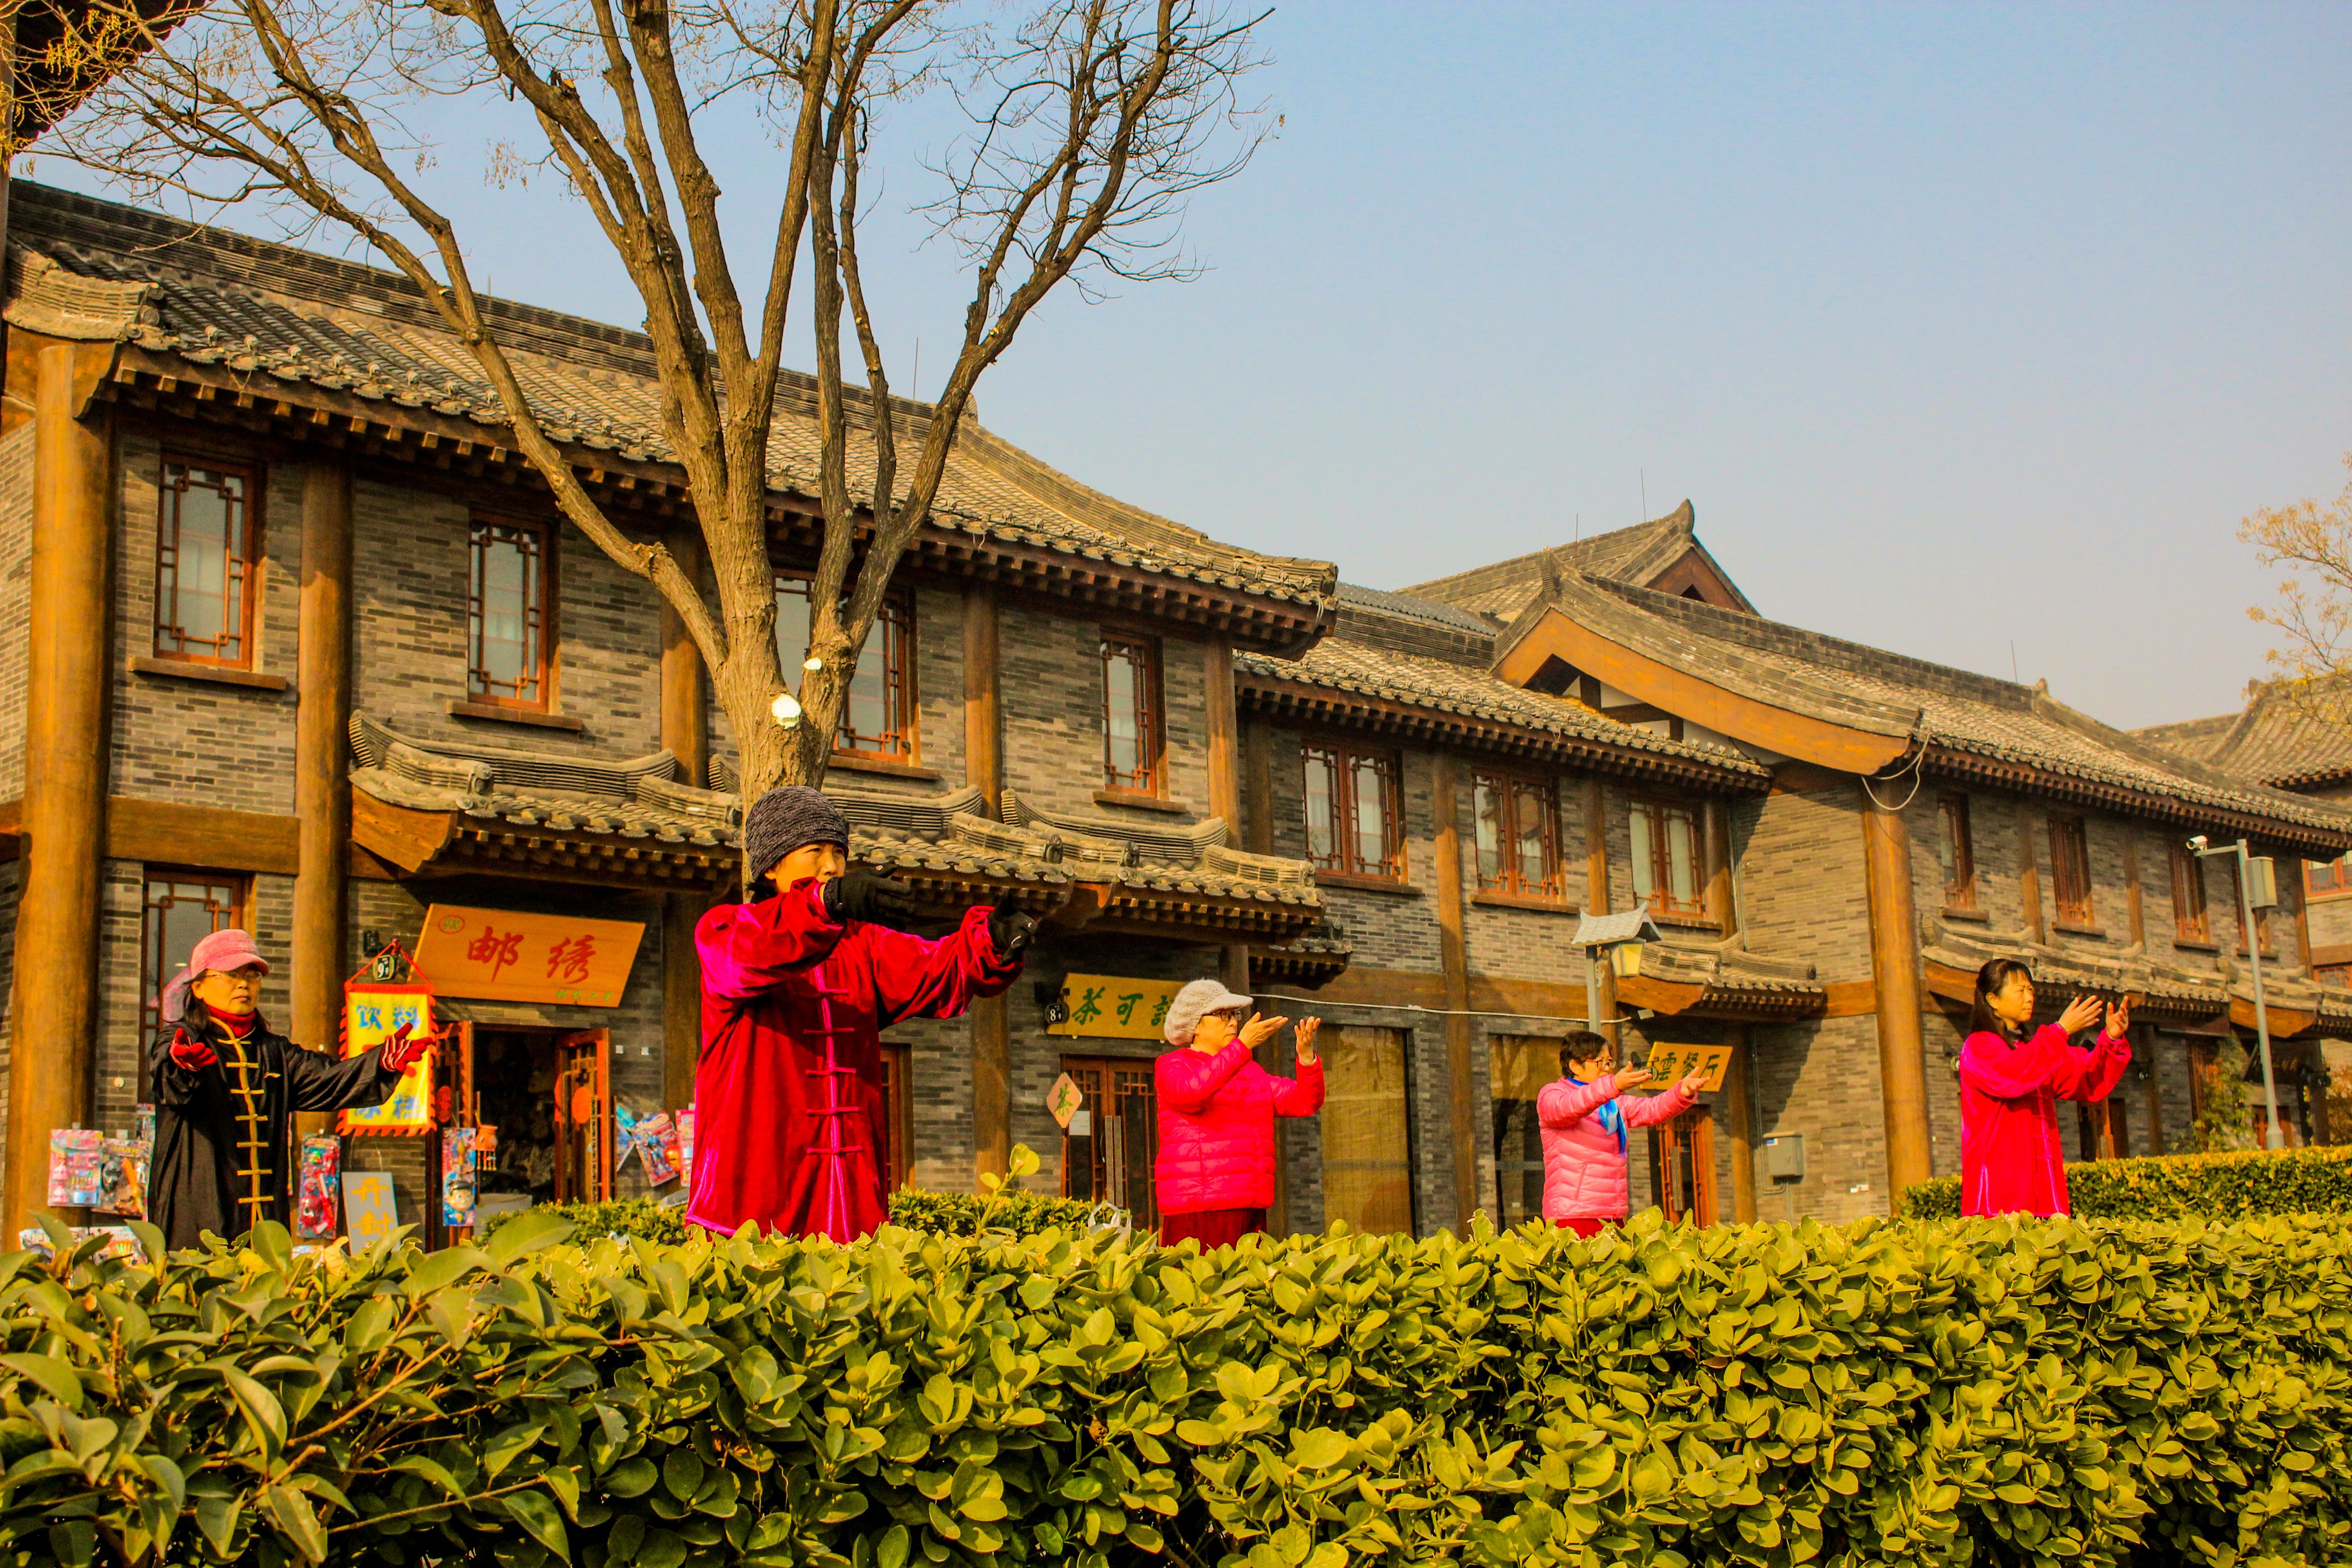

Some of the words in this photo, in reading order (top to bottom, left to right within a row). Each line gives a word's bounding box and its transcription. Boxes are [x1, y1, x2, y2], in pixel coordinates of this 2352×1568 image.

[467, 926, 596, 984] 邮绣
[1055, 1083, 1073, 1117] 茶
[351, 1176, 394, 1235] 开封
